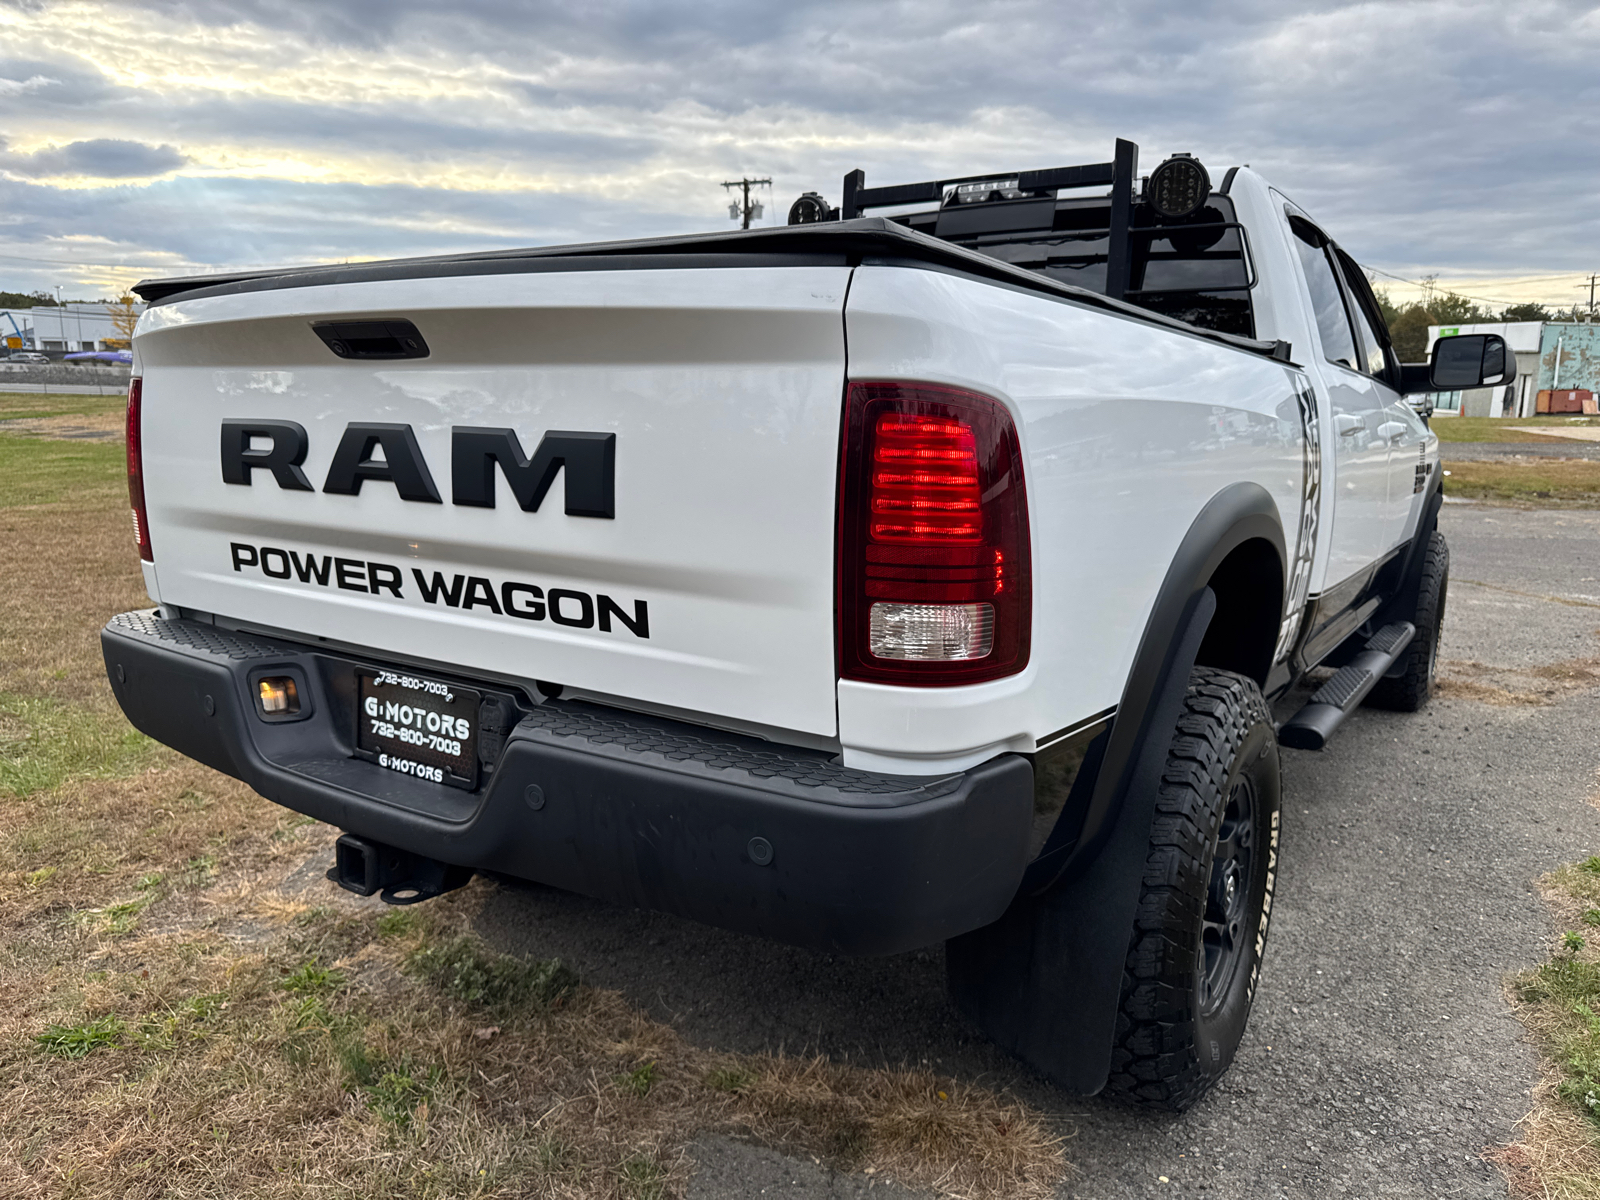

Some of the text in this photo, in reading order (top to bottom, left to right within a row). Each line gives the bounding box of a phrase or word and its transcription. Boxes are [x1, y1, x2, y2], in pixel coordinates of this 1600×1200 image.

[221, 418, 616, 519] RAM
[230, 541, 650, 639] POWER WAGON
[378, 671, 448, 696] 732-800-7003
[370, 719, 461, 756] 732-800-7003
[1254, 810, 1280, 959] GRABBER
